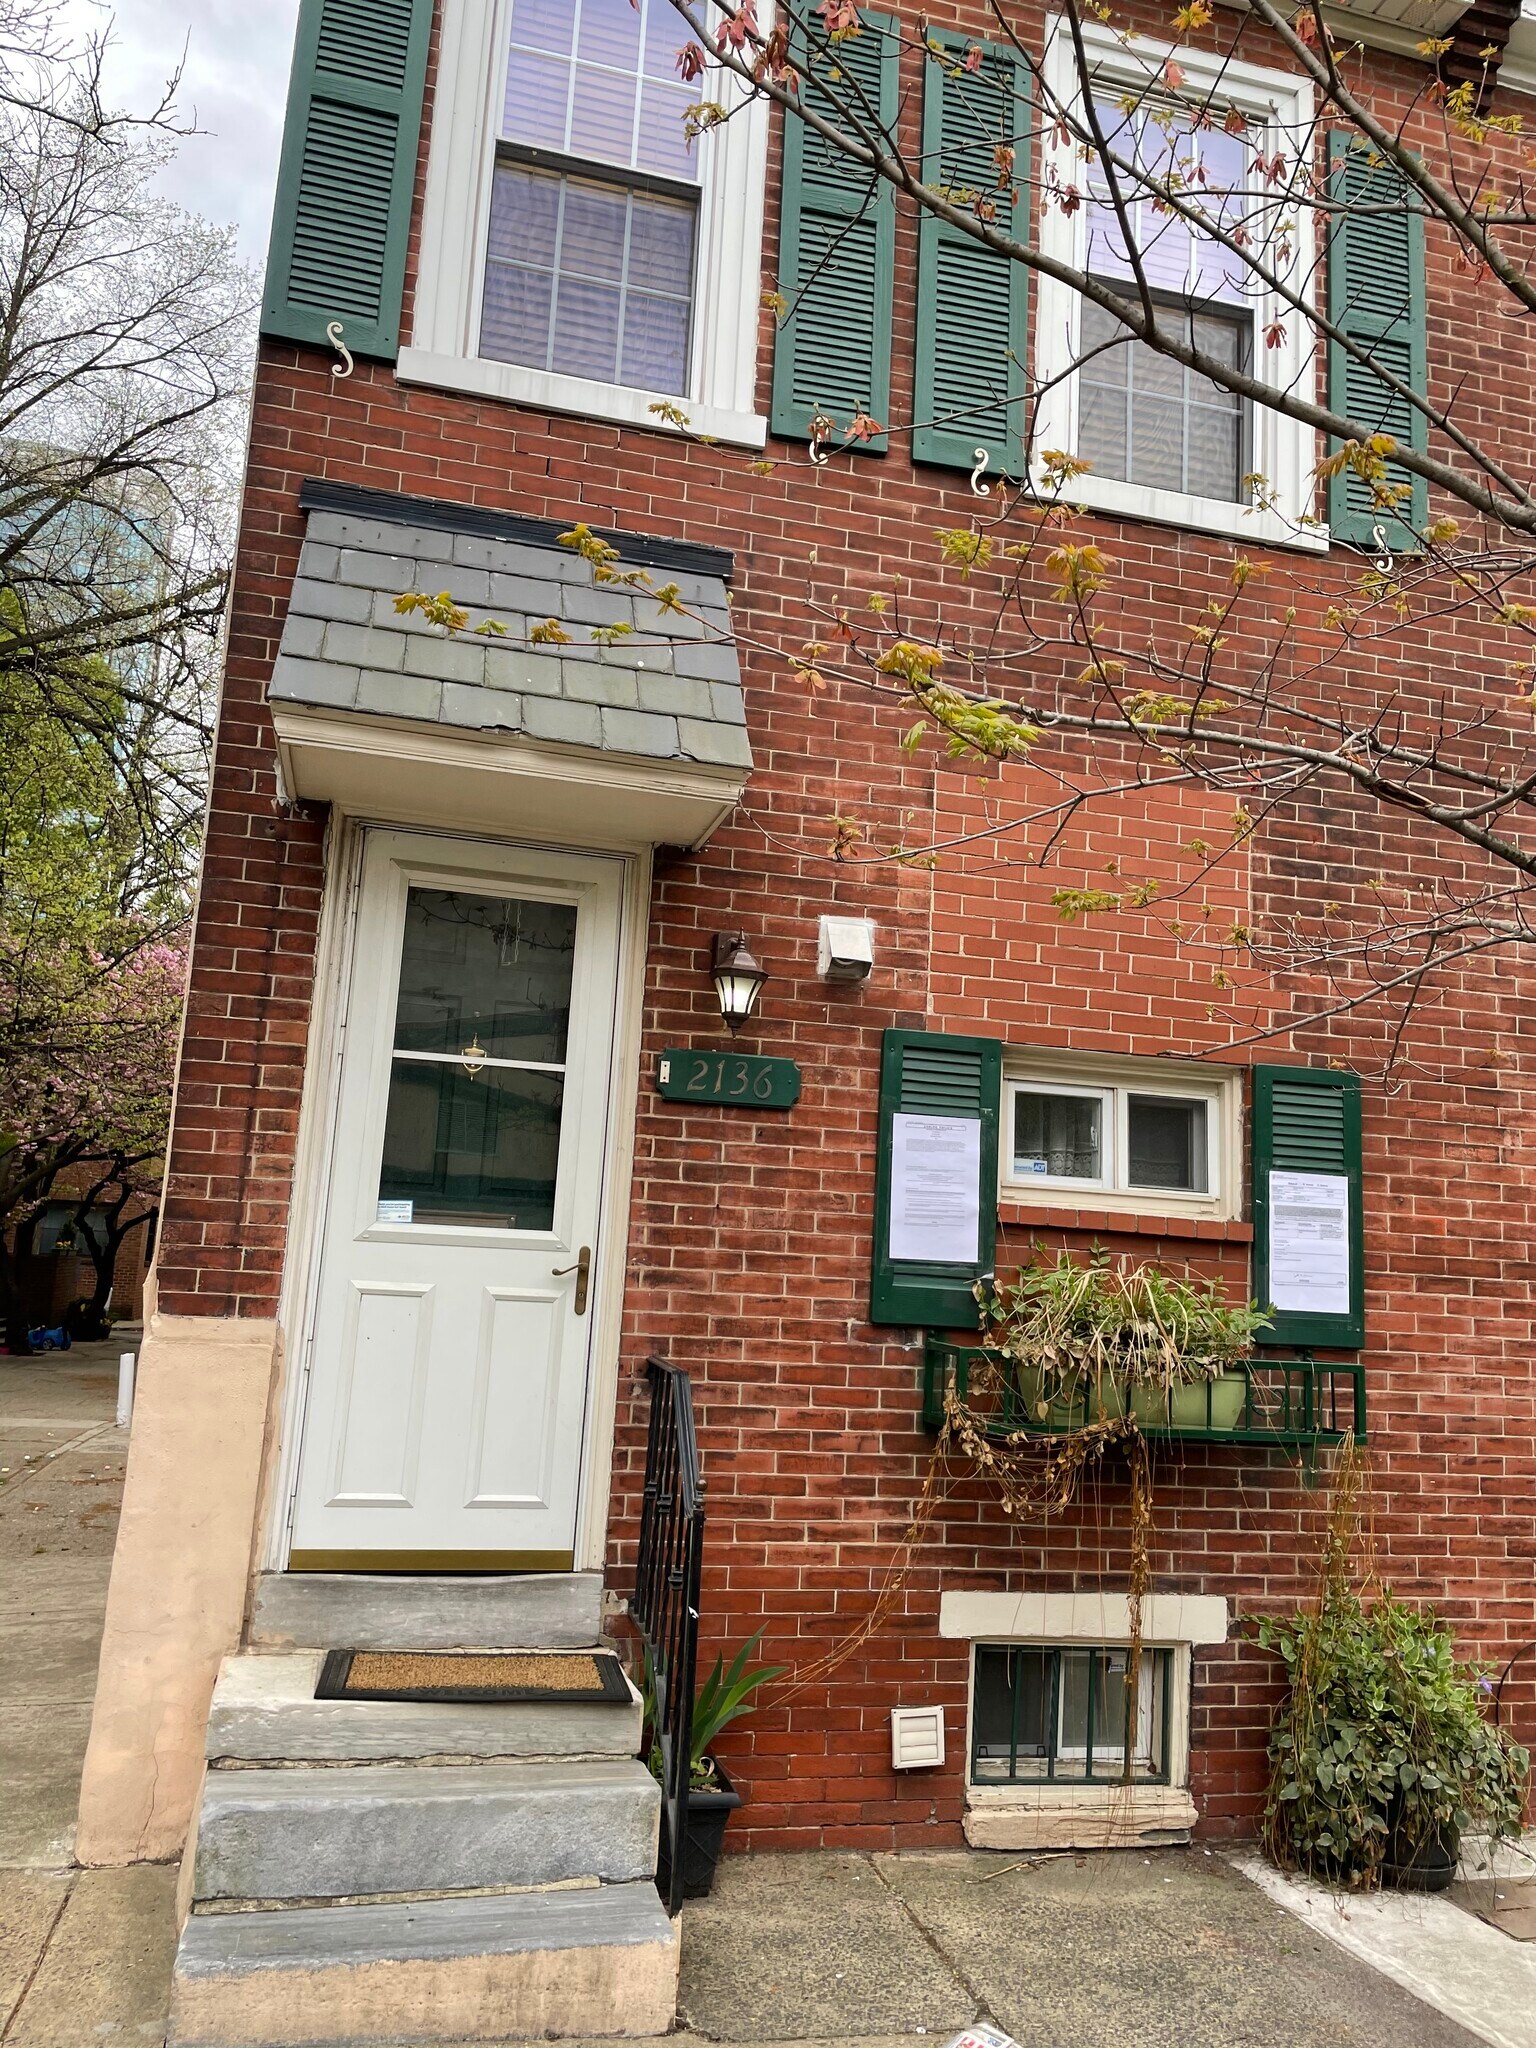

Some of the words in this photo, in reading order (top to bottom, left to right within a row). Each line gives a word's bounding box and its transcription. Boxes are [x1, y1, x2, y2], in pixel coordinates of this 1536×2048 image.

[686, 1059, 773, 1100] 2136
[1034, 1163, 1045, 1172] ADT
[419, 1688, 536, 1697] WELCOME
